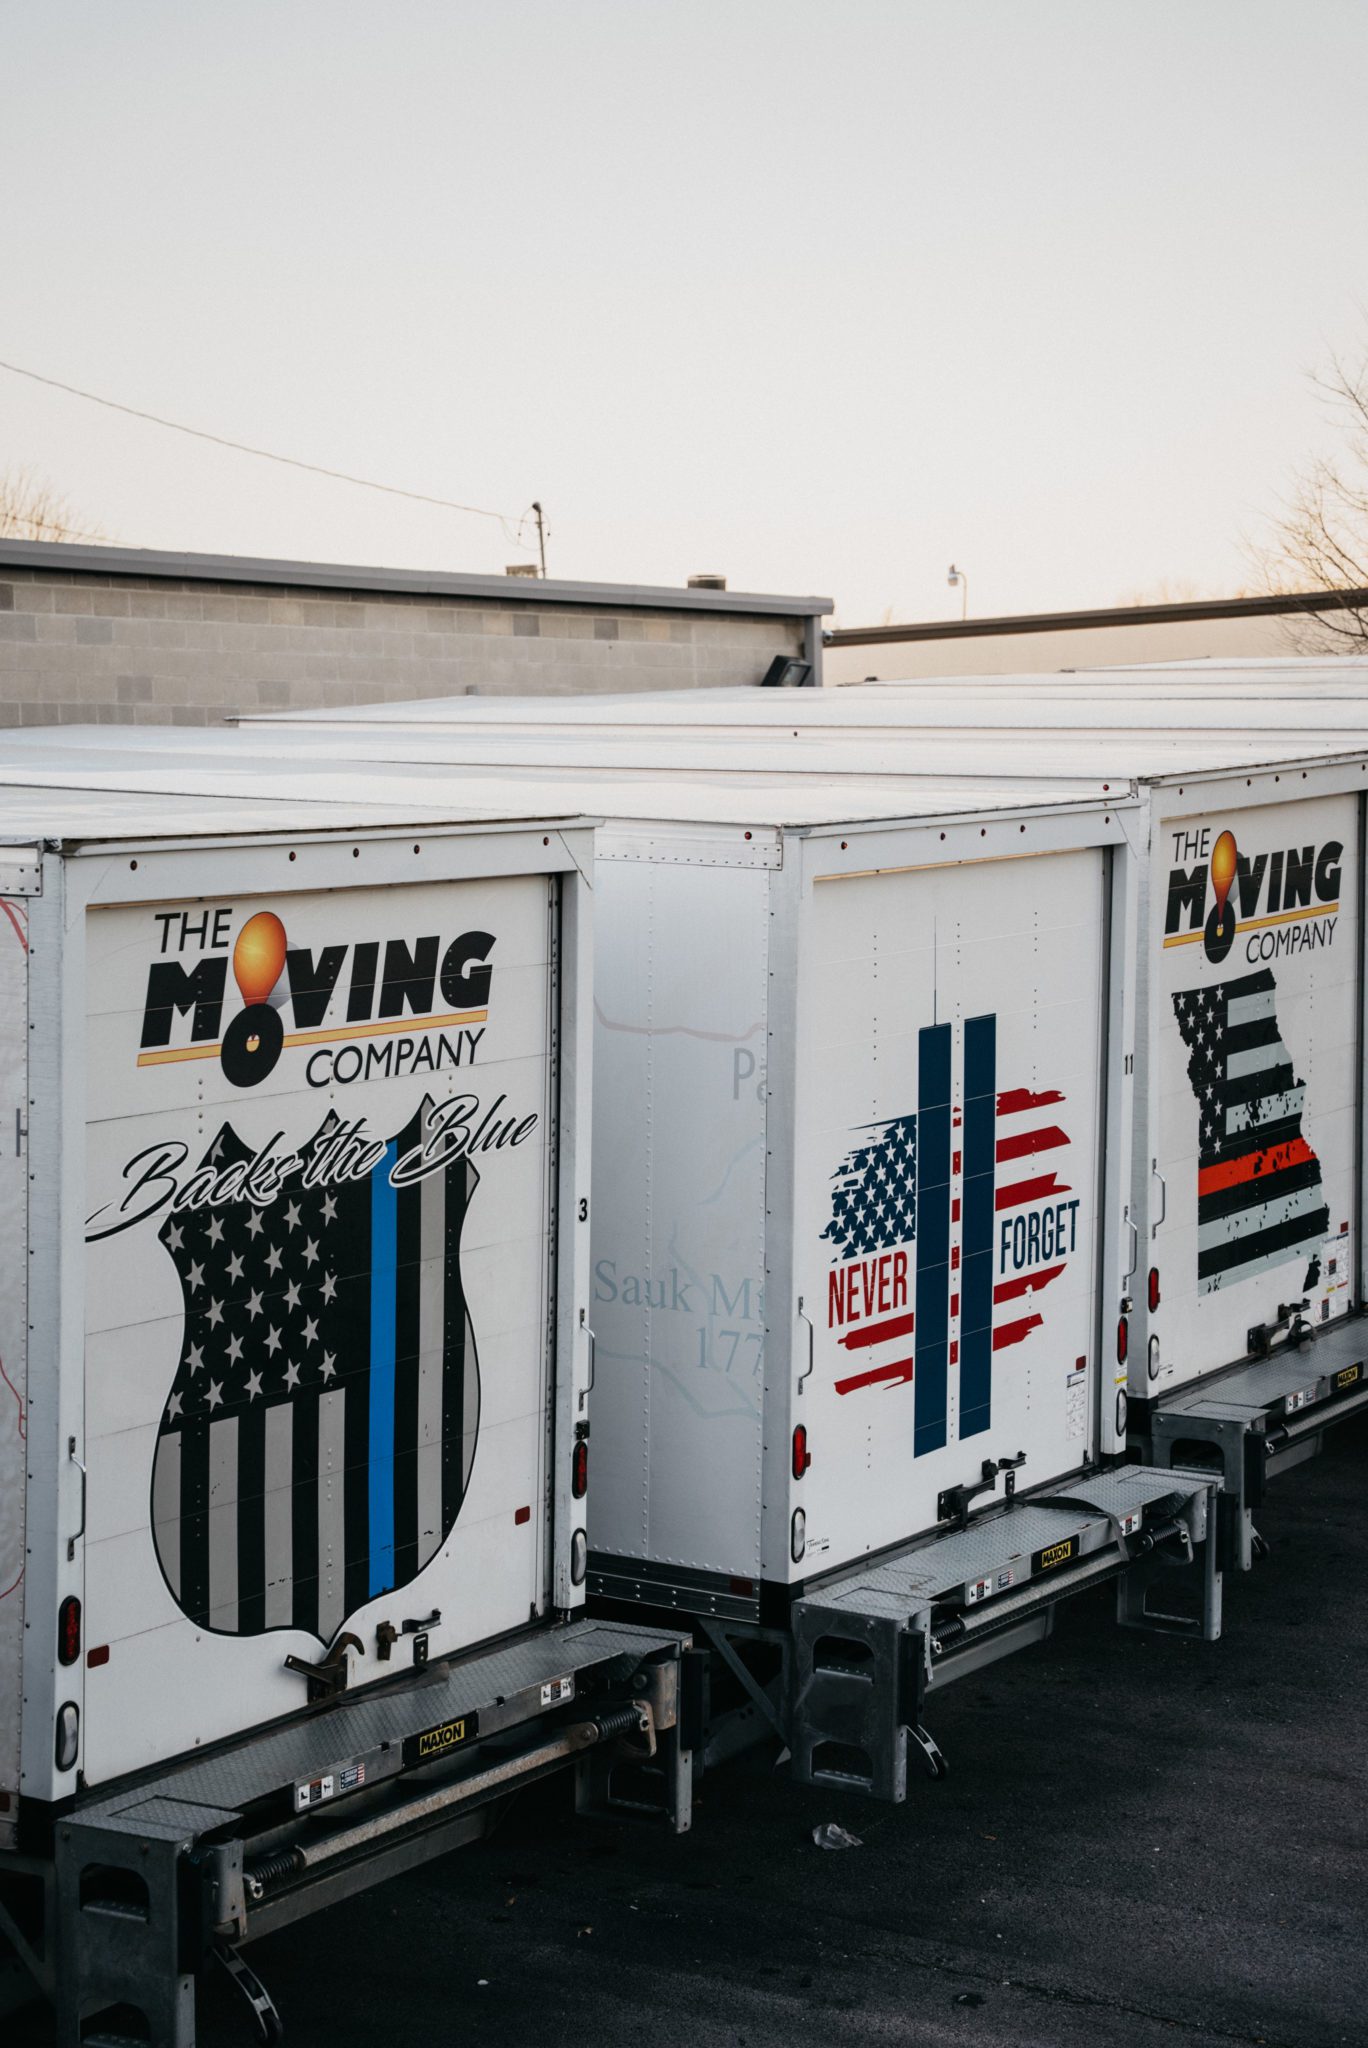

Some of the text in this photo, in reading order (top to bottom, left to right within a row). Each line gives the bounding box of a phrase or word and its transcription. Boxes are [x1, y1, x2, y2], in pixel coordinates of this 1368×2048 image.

[1172, 828, 1211, 863] THE
[1164, 830, 1345, 964] MOVING
[154, 908, 234, 953] THE
[1246, 917, 1338, 964] COMPANY
[139, 911, 498, 1088] MOVING
[304, 1027, 487, 1088] COMPANY
[1124, 1053, 1133, 1075] 11
[85, 1131, 304, 1243] Backs
[303, 1116, 388, 1188] the
[390, 1094, 539, 1186] Blue
[579, 1198, 588, 1222] 3
[595, 1259, 694, 1313] Sauk
[828, 1200, 1080, 1328] NEVER FORGET
[1042, 1542, 1071, 1567] MAXON
[420, 1722, 462, 1754] MAXON
